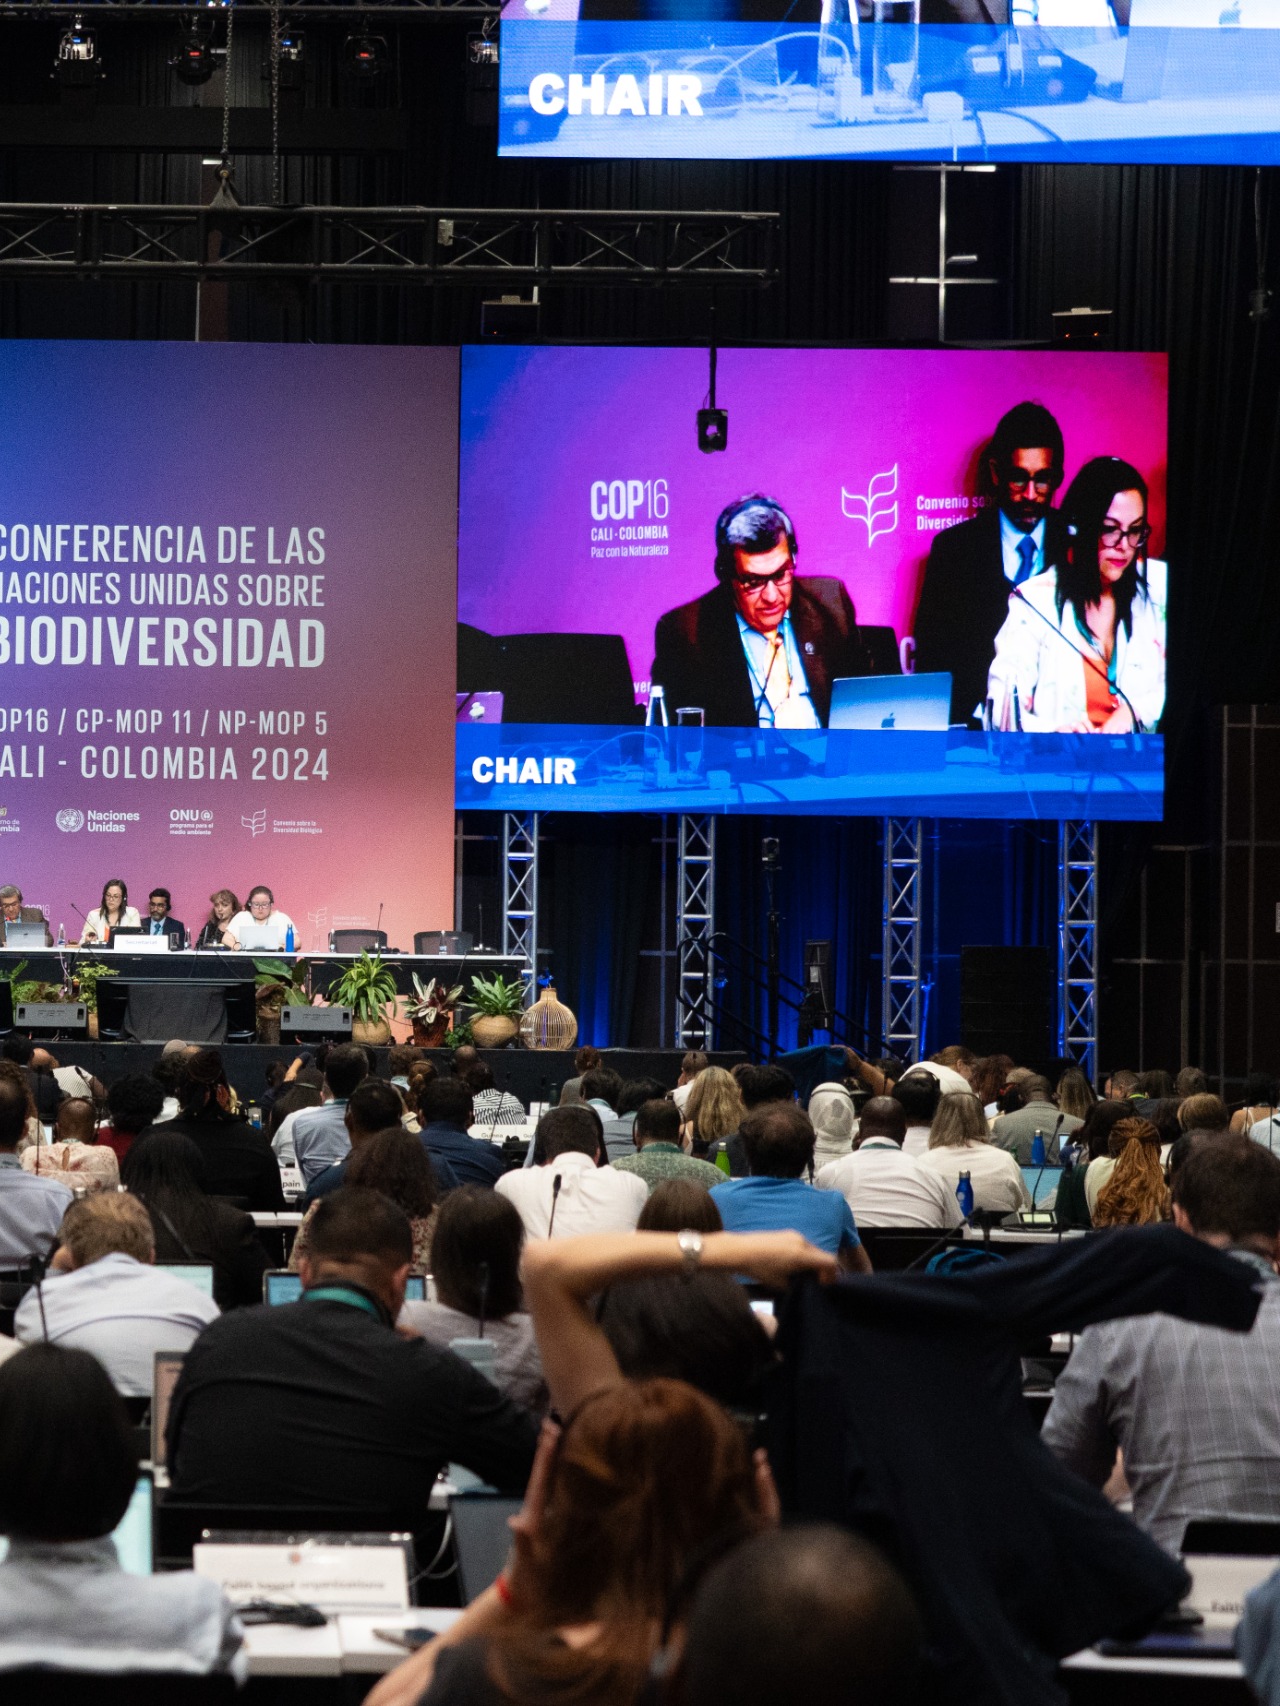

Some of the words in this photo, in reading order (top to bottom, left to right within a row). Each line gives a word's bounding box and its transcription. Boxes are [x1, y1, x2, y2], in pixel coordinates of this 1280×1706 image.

[528, 72, 704, 116] CHAIR
[590, 479, 669, 521] COP16
[916, 495, 969, 510] Convenio
[916, 514, 977, 530] Diversid
[591, 527, 613, 541] CALI
[619, 525, 668, 540] COLOMBIA
[217, 526, 256, 564] DE
[267, 526, 326, 565] LAS
[591, 546, 604, 558] Paz
[605, 546, 620, 558] con
[621, 545, 628, 557] la
[629, 544, 669, 557] Naturaleza
[130, 572, 229, 606] UNIDAS
[237, 573, 325, 607] SOBRE
[76, 708, 163, 734] CP-MOP
[172, 709, 191, 734] 11
[219, 709, 306, 735] NP-MOP
[315, 711, 327, 736] 5
[81, 745, 238, 780] COLOMBIA
[252, 747, 329, 781] 2024
[472, 756, 577, 785] CHAIR
[87, 810, 140, 821] Naciones
[170, 809, 199, 821] ONU
[87, 821, 126, 832] Unidas
[282, 1180, 302, 1189] pain
